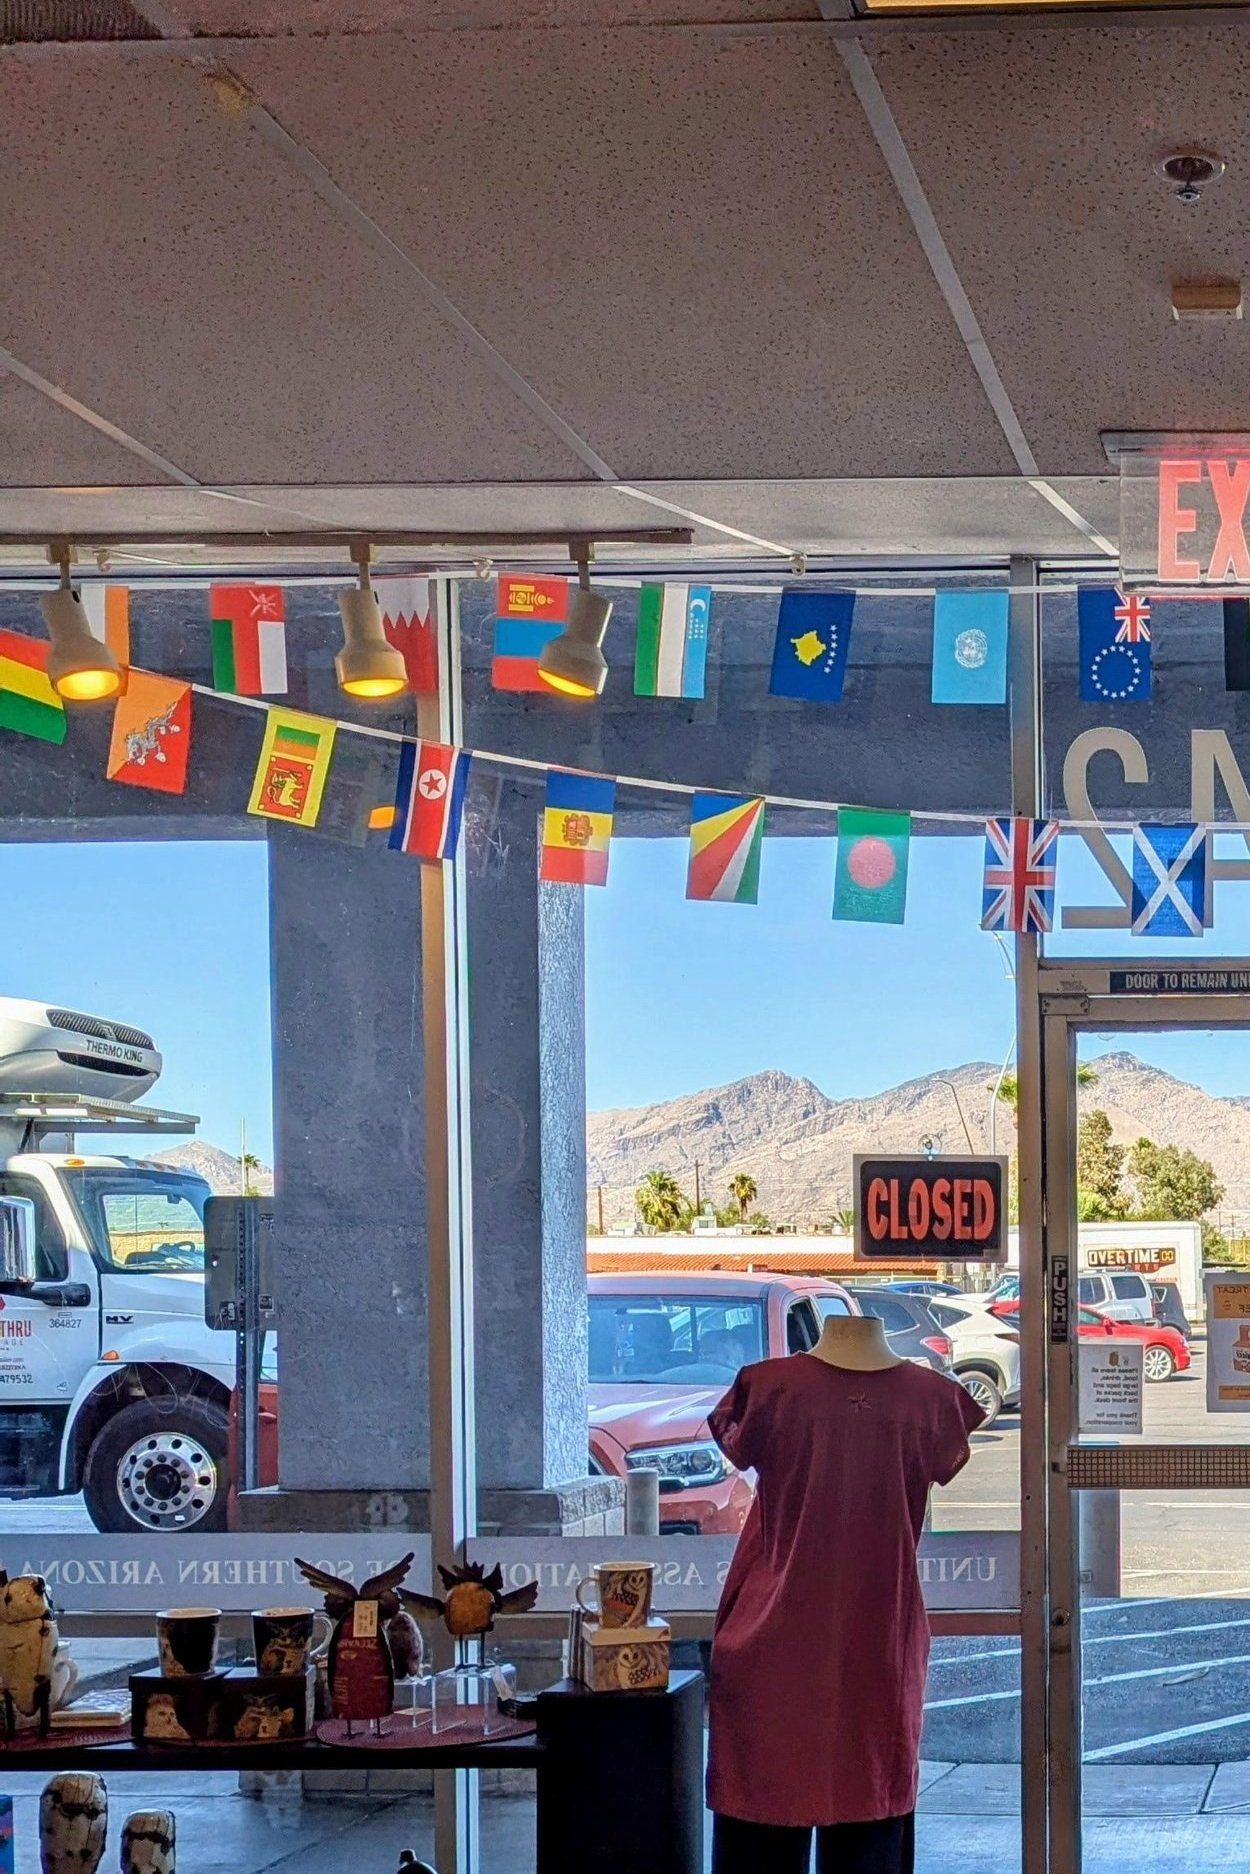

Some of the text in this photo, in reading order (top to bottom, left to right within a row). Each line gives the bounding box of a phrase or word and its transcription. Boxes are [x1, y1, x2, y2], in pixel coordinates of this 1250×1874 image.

[1125, 973, 1159, 989] DOOR
[1163, 973, 1178, 988] TO
[1181, 973, 1228, 988] REMAIN
[86, 1040, 143, 1063] THERMO KING
[868, 1178, 995, 1240] CLOSED
[1089, 1248, 1160, 1265] OVERTIME
[1053, 1261, 1067, 1322] PUSH
[0, 1320, 32, 1337] THRU
[48, 1319, 81, 1329] 364827
